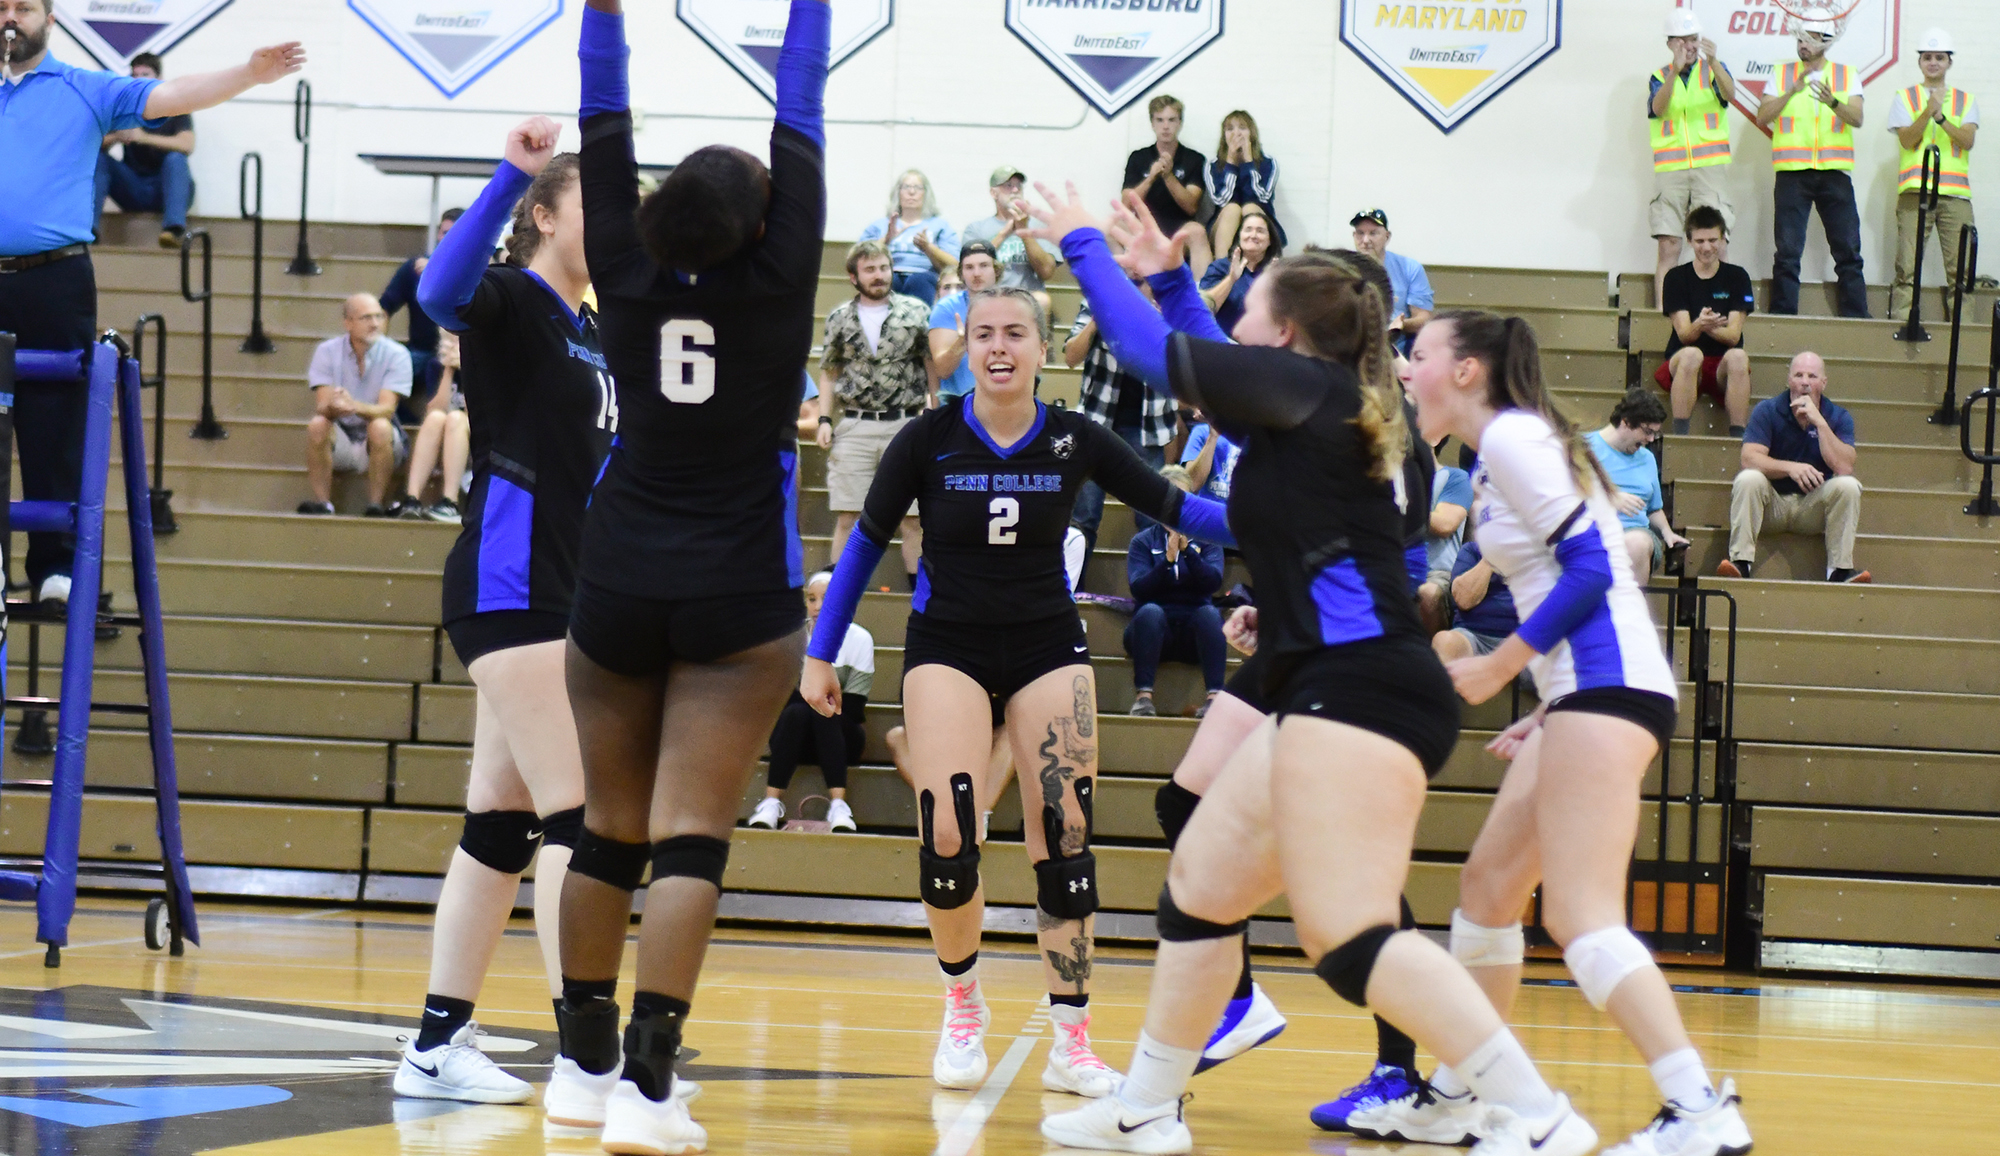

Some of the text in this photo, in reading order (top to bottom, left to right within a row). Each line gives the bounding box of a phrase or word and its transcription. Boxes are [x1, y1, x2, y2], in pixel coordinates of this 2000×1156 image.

[1374, 5, 1528, 33] MARYLAND
[660, 319, 716, 404] 6
[944, 474, 1062, 492] PENN COLLEGE
[988, 497, 1020, 545] 2
